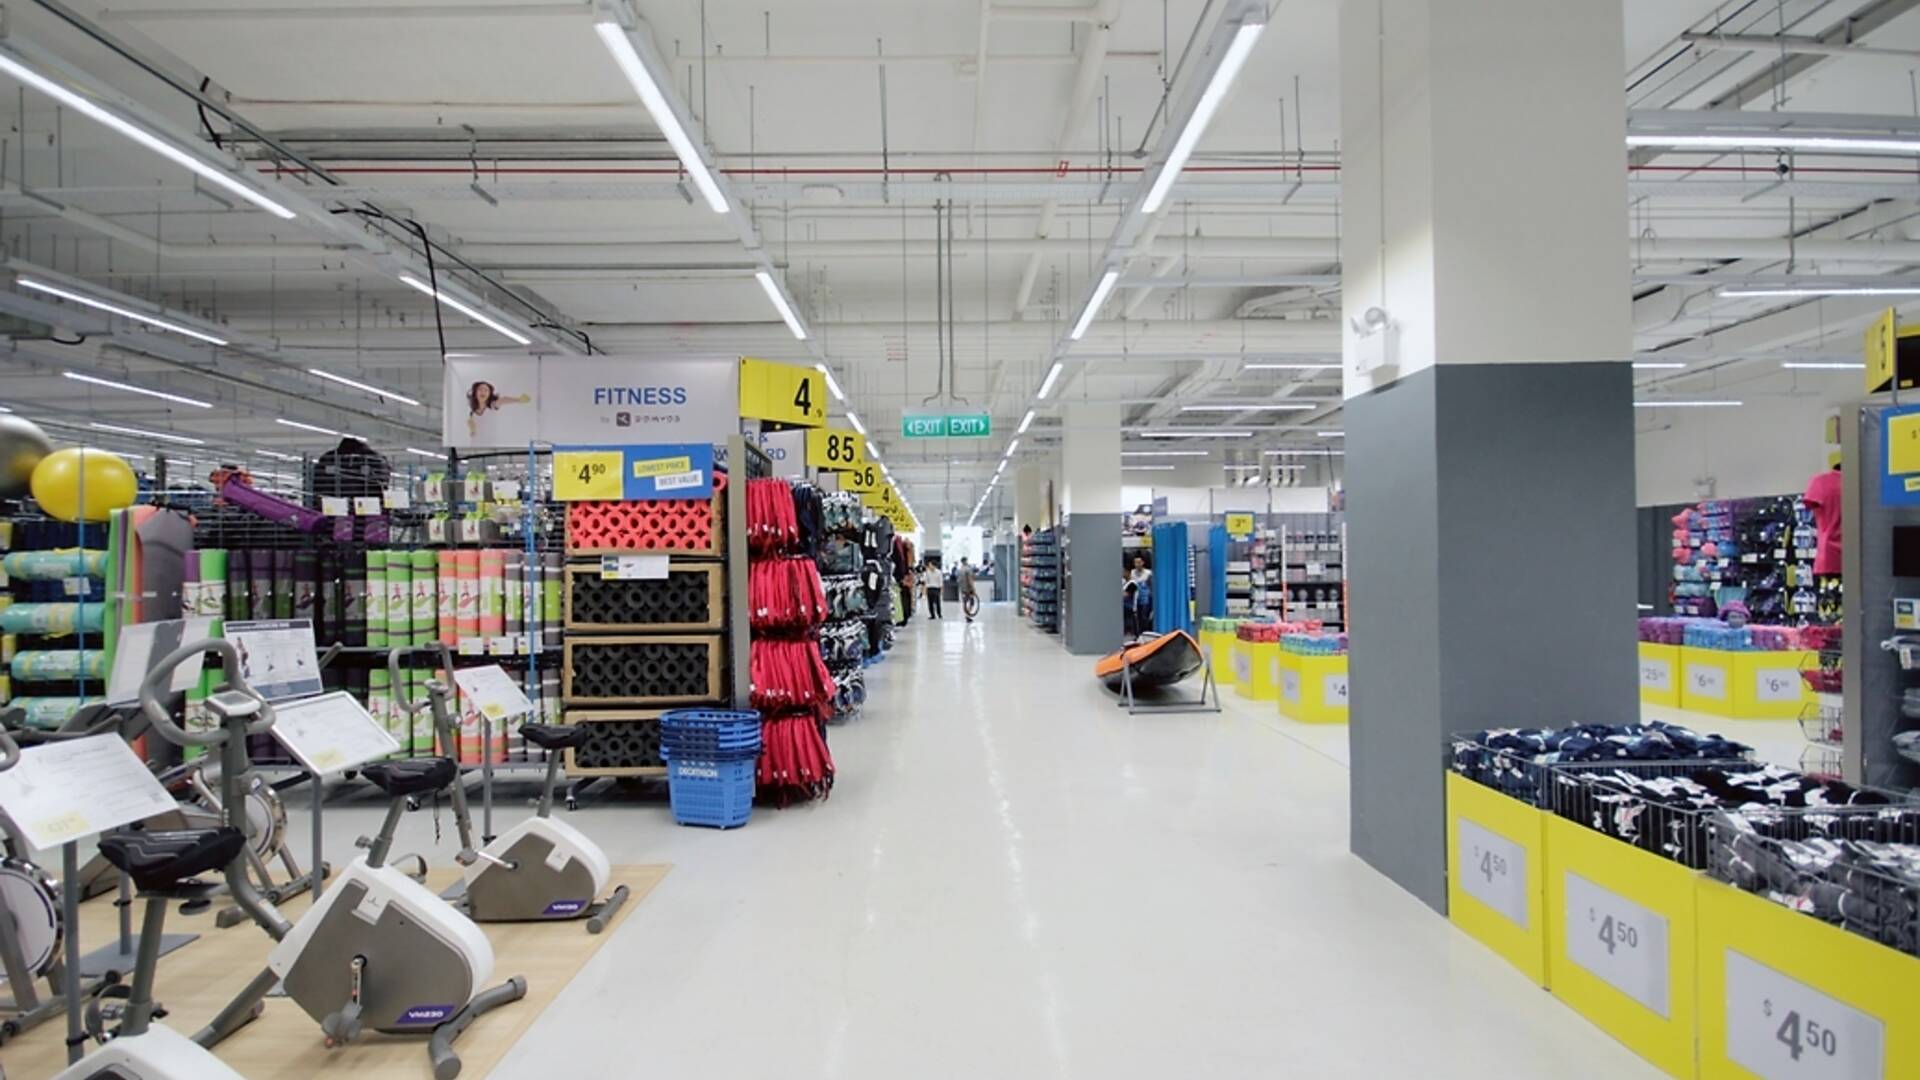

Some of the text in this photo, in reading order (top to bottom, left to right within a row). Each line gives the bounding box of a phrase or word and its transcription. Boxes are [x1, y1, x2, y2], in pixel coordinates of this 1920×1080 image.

[594, 387, 687, 405] FITNESS
[794, 377, 812, 417] 4
[914, 420, 942, 434] EXIT
[951, 419, 979, 433] EXIT
[827, 435, 855, 462] 85
[637, 460, 685, 473] LOWEST PRICE
[659, 474, 699, 486] BEST VALUE
[854, 466, 874, 487] 56
